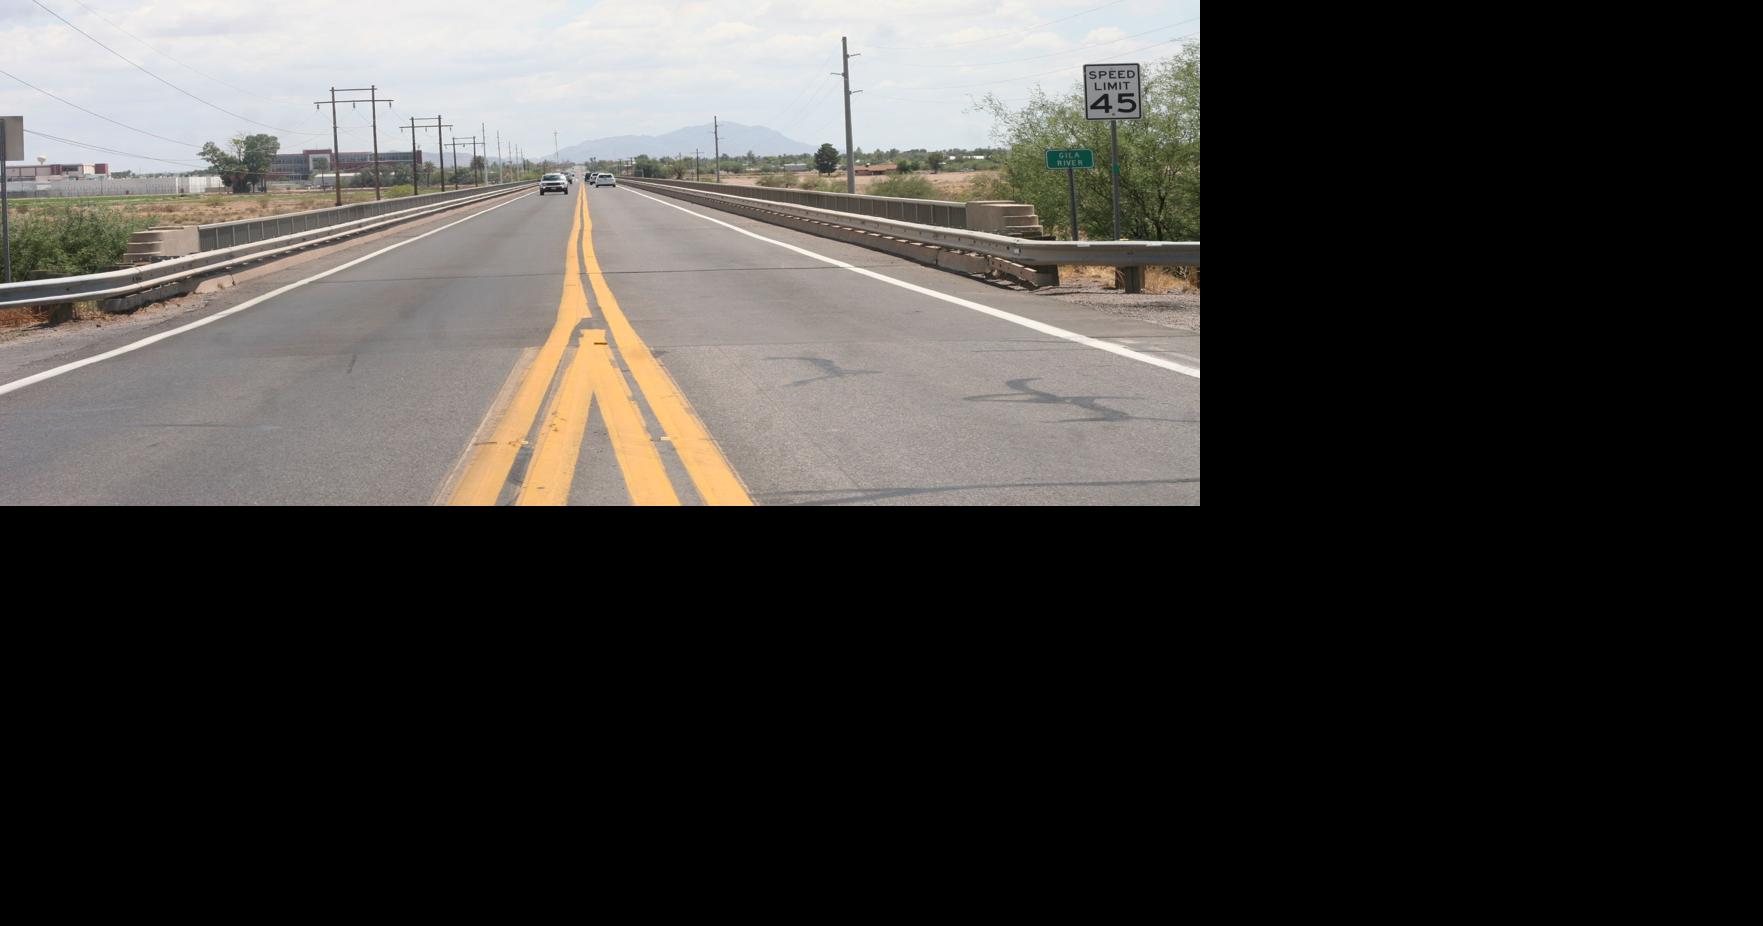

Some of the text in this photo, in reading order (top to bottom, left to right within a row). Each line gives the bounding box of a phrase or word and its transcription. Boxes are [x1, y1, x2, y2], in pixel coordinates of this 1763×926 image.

[1088, 70, 1136, 80] SPEED
[1094, 81, 1131, 91] LIMIT
[1090, 93, 1137, 114] 45
[1058, 151, 1080, 160] GILA
[1056, 159, 1083, 167] RIVER
